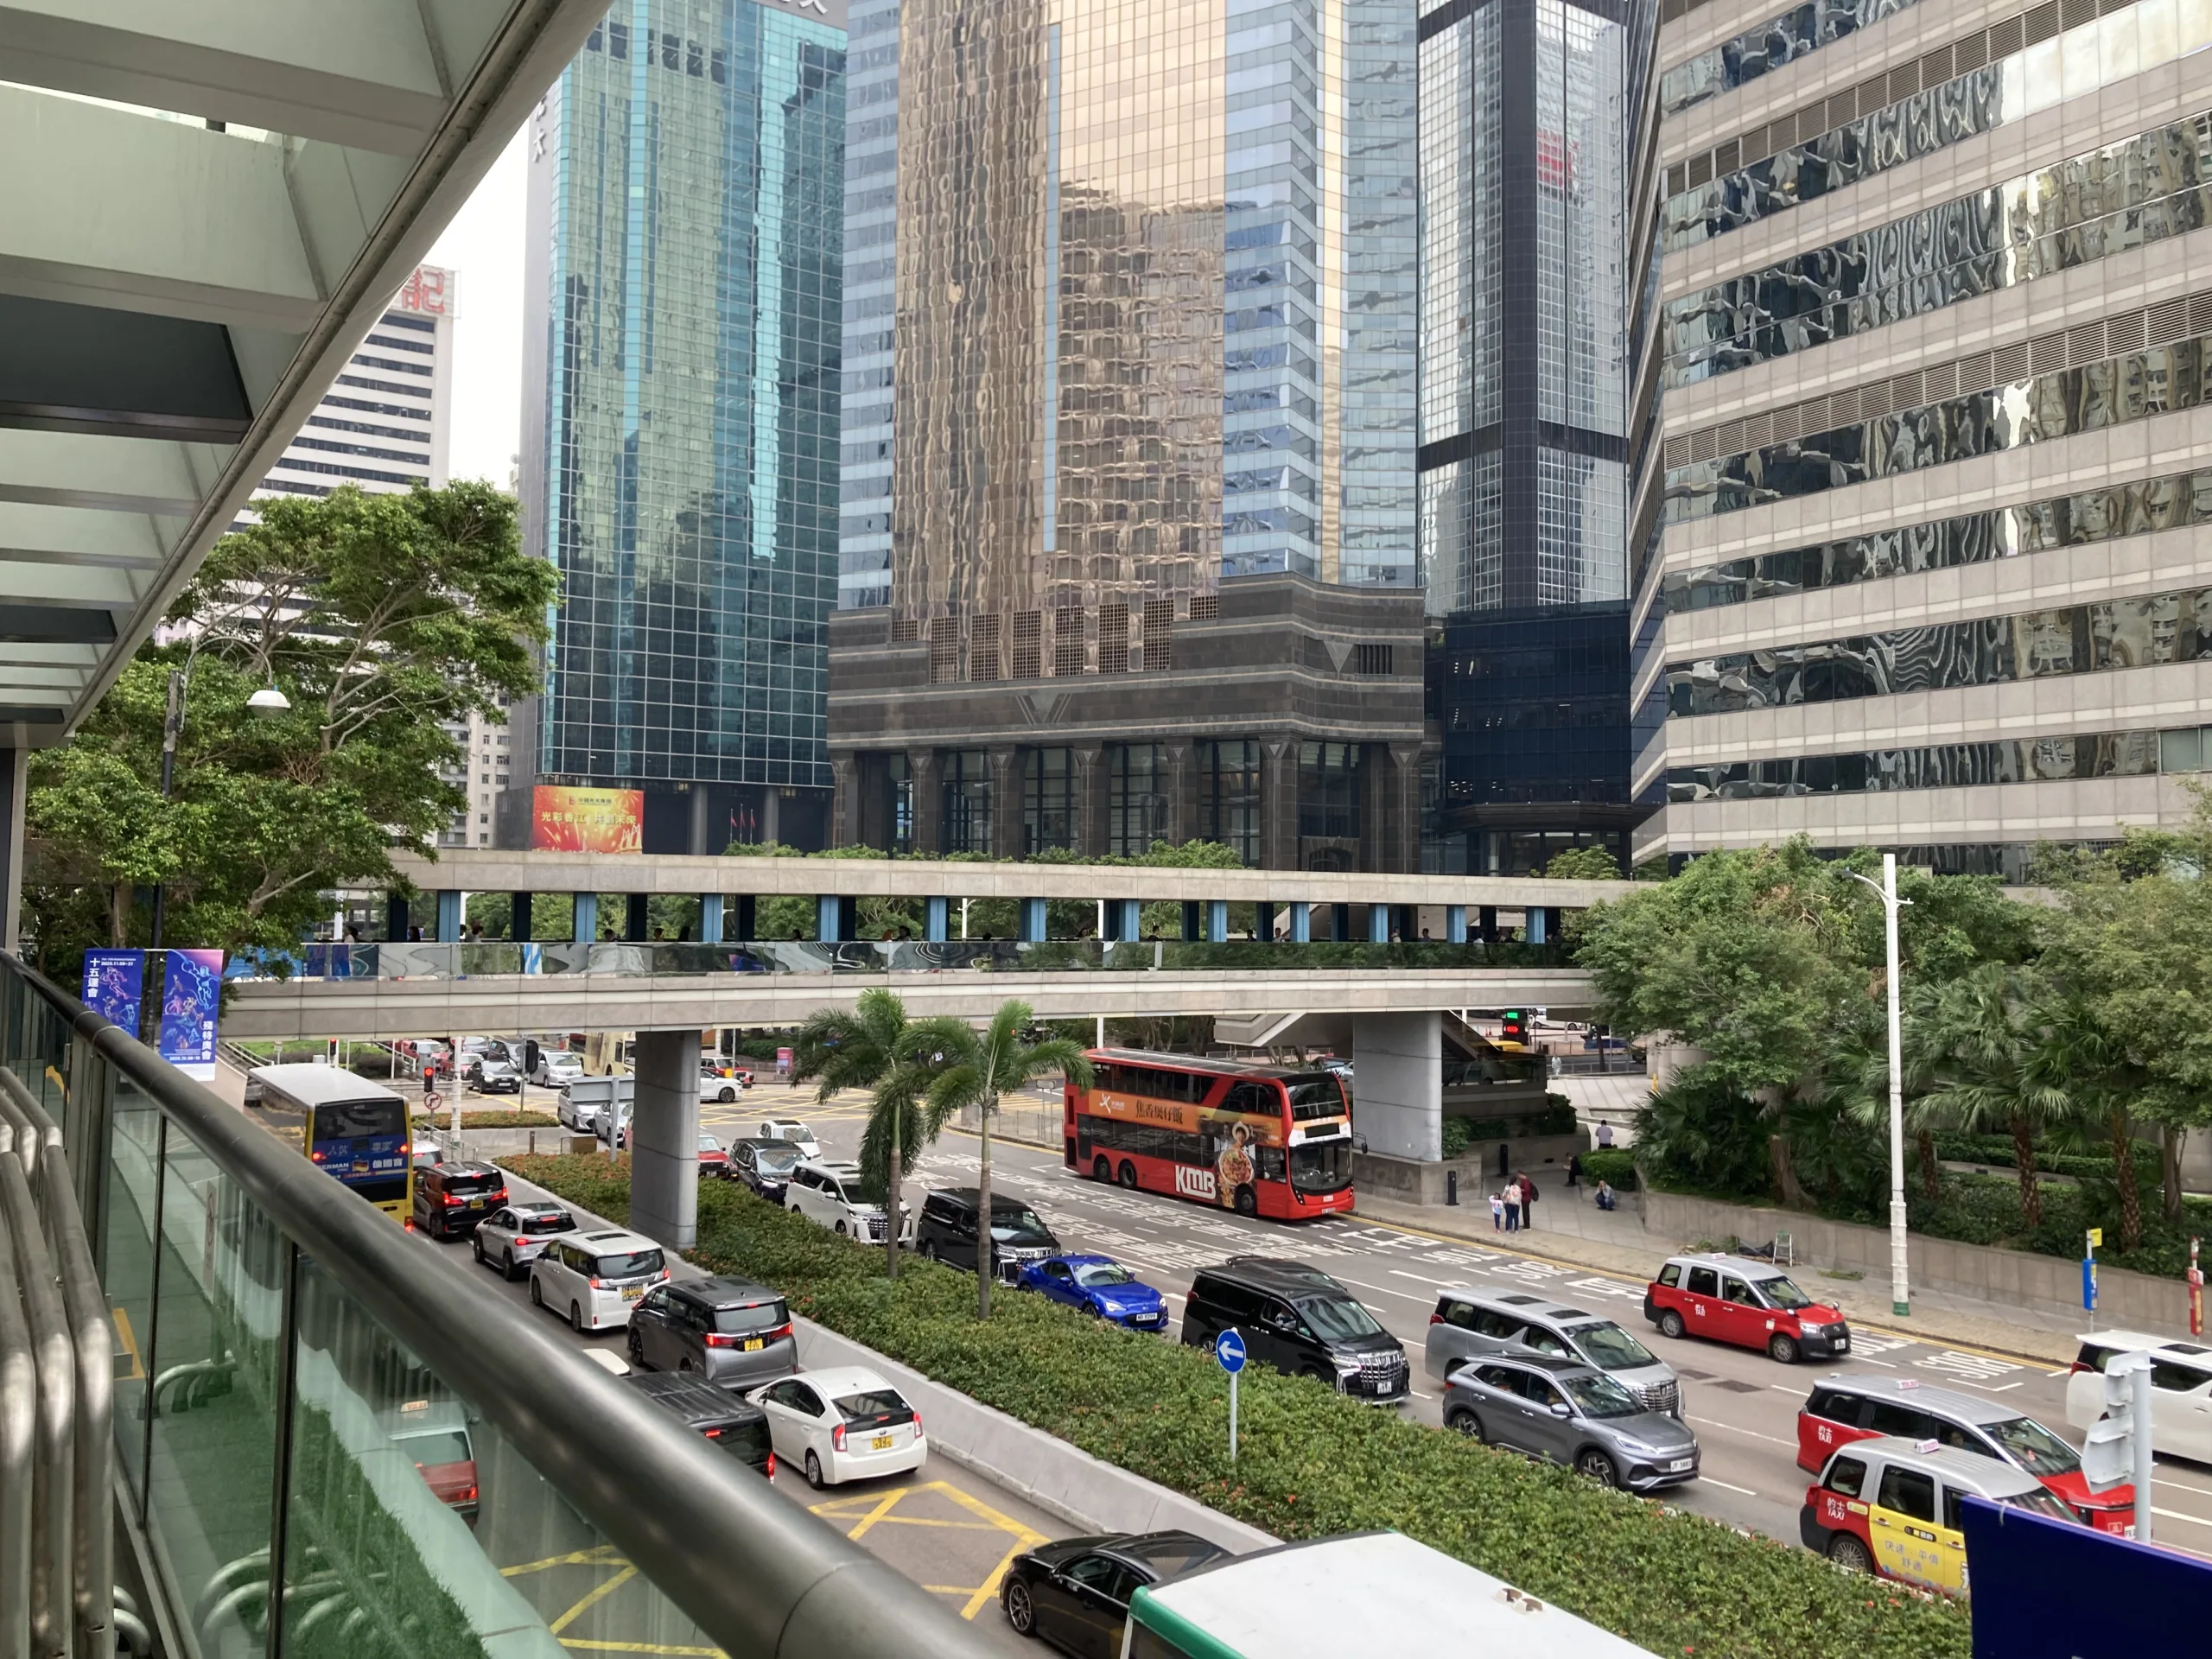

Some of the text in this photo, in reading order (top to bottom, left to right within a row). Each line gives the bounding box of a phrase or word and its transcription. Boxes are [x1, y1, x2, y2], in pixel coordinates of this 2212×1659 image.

[1175, 1165, 1216, 1199] KMB
[1490, 1261, 1579, 1280] BUS
[1911, 1350, 2024, 1380] BUS
[1817, 1432, 1832, 1444] TAXI
[1827, 1497, 1846, 1511] 的士
[1827, 1508, 1845, 1521] TAXI
